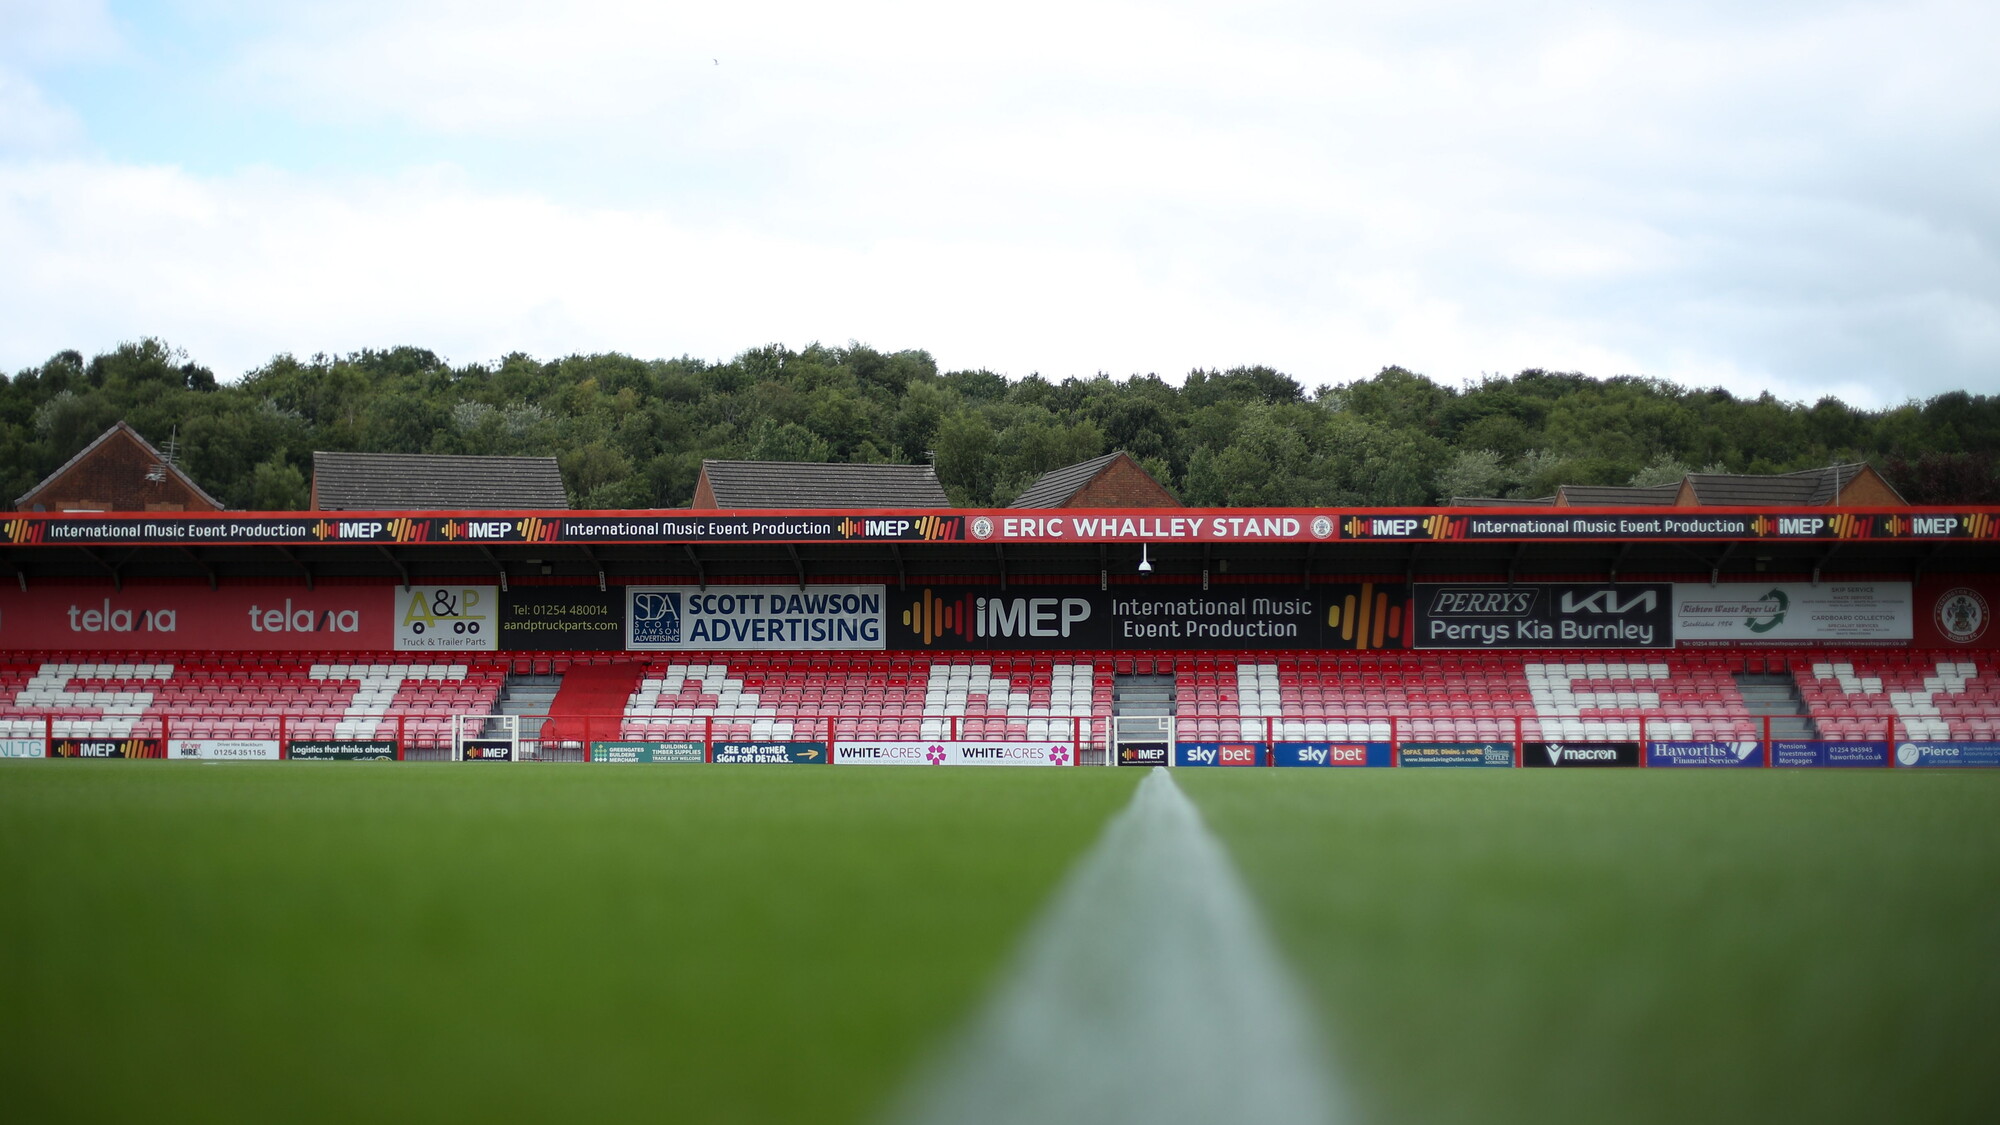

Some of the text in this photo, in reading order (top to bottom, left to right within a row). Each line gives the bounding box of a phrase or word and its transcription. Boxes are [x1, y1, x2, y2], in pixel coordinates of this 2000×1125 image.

[51, 523, 306, 537] International Music Event Production
[339, 522, 382, 538] iMEP
[468, 522, 512, 538] iMEP
[565, 521, 831, 536] International Music Event Production
[865, 520, 910, 536] iMEP
[1003, 518, 1064, 537] ERIC
[1072, 518, 1204, 537] WHALLEY
[1212, 518, 1300, 537] STAND
[1372, 519, 1418, 535] iMEP
[1473, 520, 1745, 533] International Music Event Production
[1779, 518, 1824, 534] iMEP
[1913, 518, 1958, 534] iMEP
[513, 605, 608, 615] Tel: 01254 480014
[635, 594, 680, 621] SDA
[689, 594, 880, 615] SCOTT DAWSON
[1112, 598, 1312, 616] International Music
[1434, 593, 1531, 613] PERRYS
[1682, 605, 1777, 614] Rishton Waste Paper Ltd
[67, 598, 176, 632] telana
[248, 598, 359, 632] telana
[976, 597, 1092, 638] iMEP
[504, 620, 618, 632] aandptruckparts.com
[689, 618, 880, 642] ADVERTISING
[1124, 620, 1297, 638] Event Production
[1430, 619, 1653, 644] Perrys Kia Burnley
[403, 638, 486, 646] Truck & Trailer Parts
[80, 743, 116, 757] iMEP
[292, 745, 392, 755] Logistics that thinks ahead.
[482, 748, 508, 758] iMEP
[724, 745, 786, 754] SEE OUR OTHER
[840, 747, 921, 758] WHITEACRES
[962, 748, 1044, 758] WHITEACRES
[1138, 749, 1164, 759] iMEP
[1187, 746, 1251, 764] sky bet
[1298, 746, 1362, 764] sky bet
[1564, 750, 1617, 760] macron
[1655, 743, 1727, 757] Haworths
[1922, 746, 1960, 756] Pierce
[716, 754, 736, 763] SIGN
[737, 754, 753, 763] FOR
